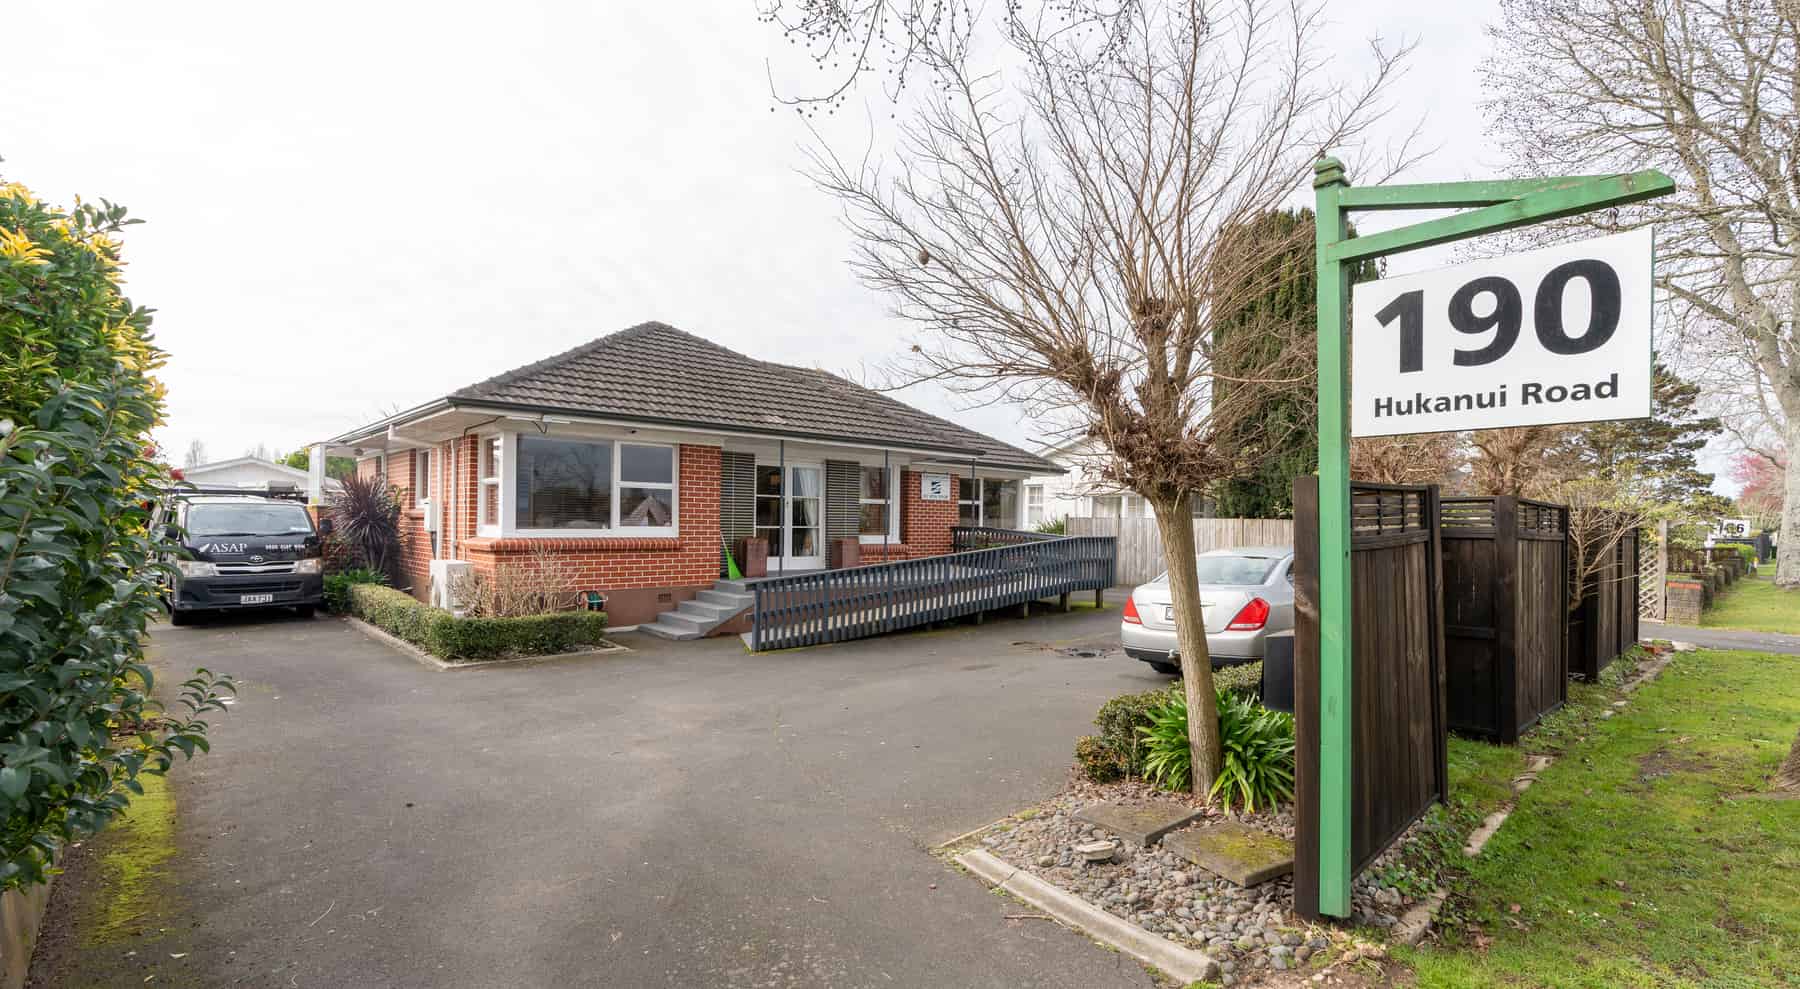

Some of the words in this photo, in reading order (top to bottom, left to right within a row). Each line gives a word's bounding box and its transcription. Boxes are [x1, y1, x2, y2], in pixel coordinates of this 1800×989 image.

[1374, 259, 1621, 373] 190
[1374, 385, 1506, 417] Hukanui
[1521, 373, 1618, 405] Road
[210, 543, 248, 553] ASAP
